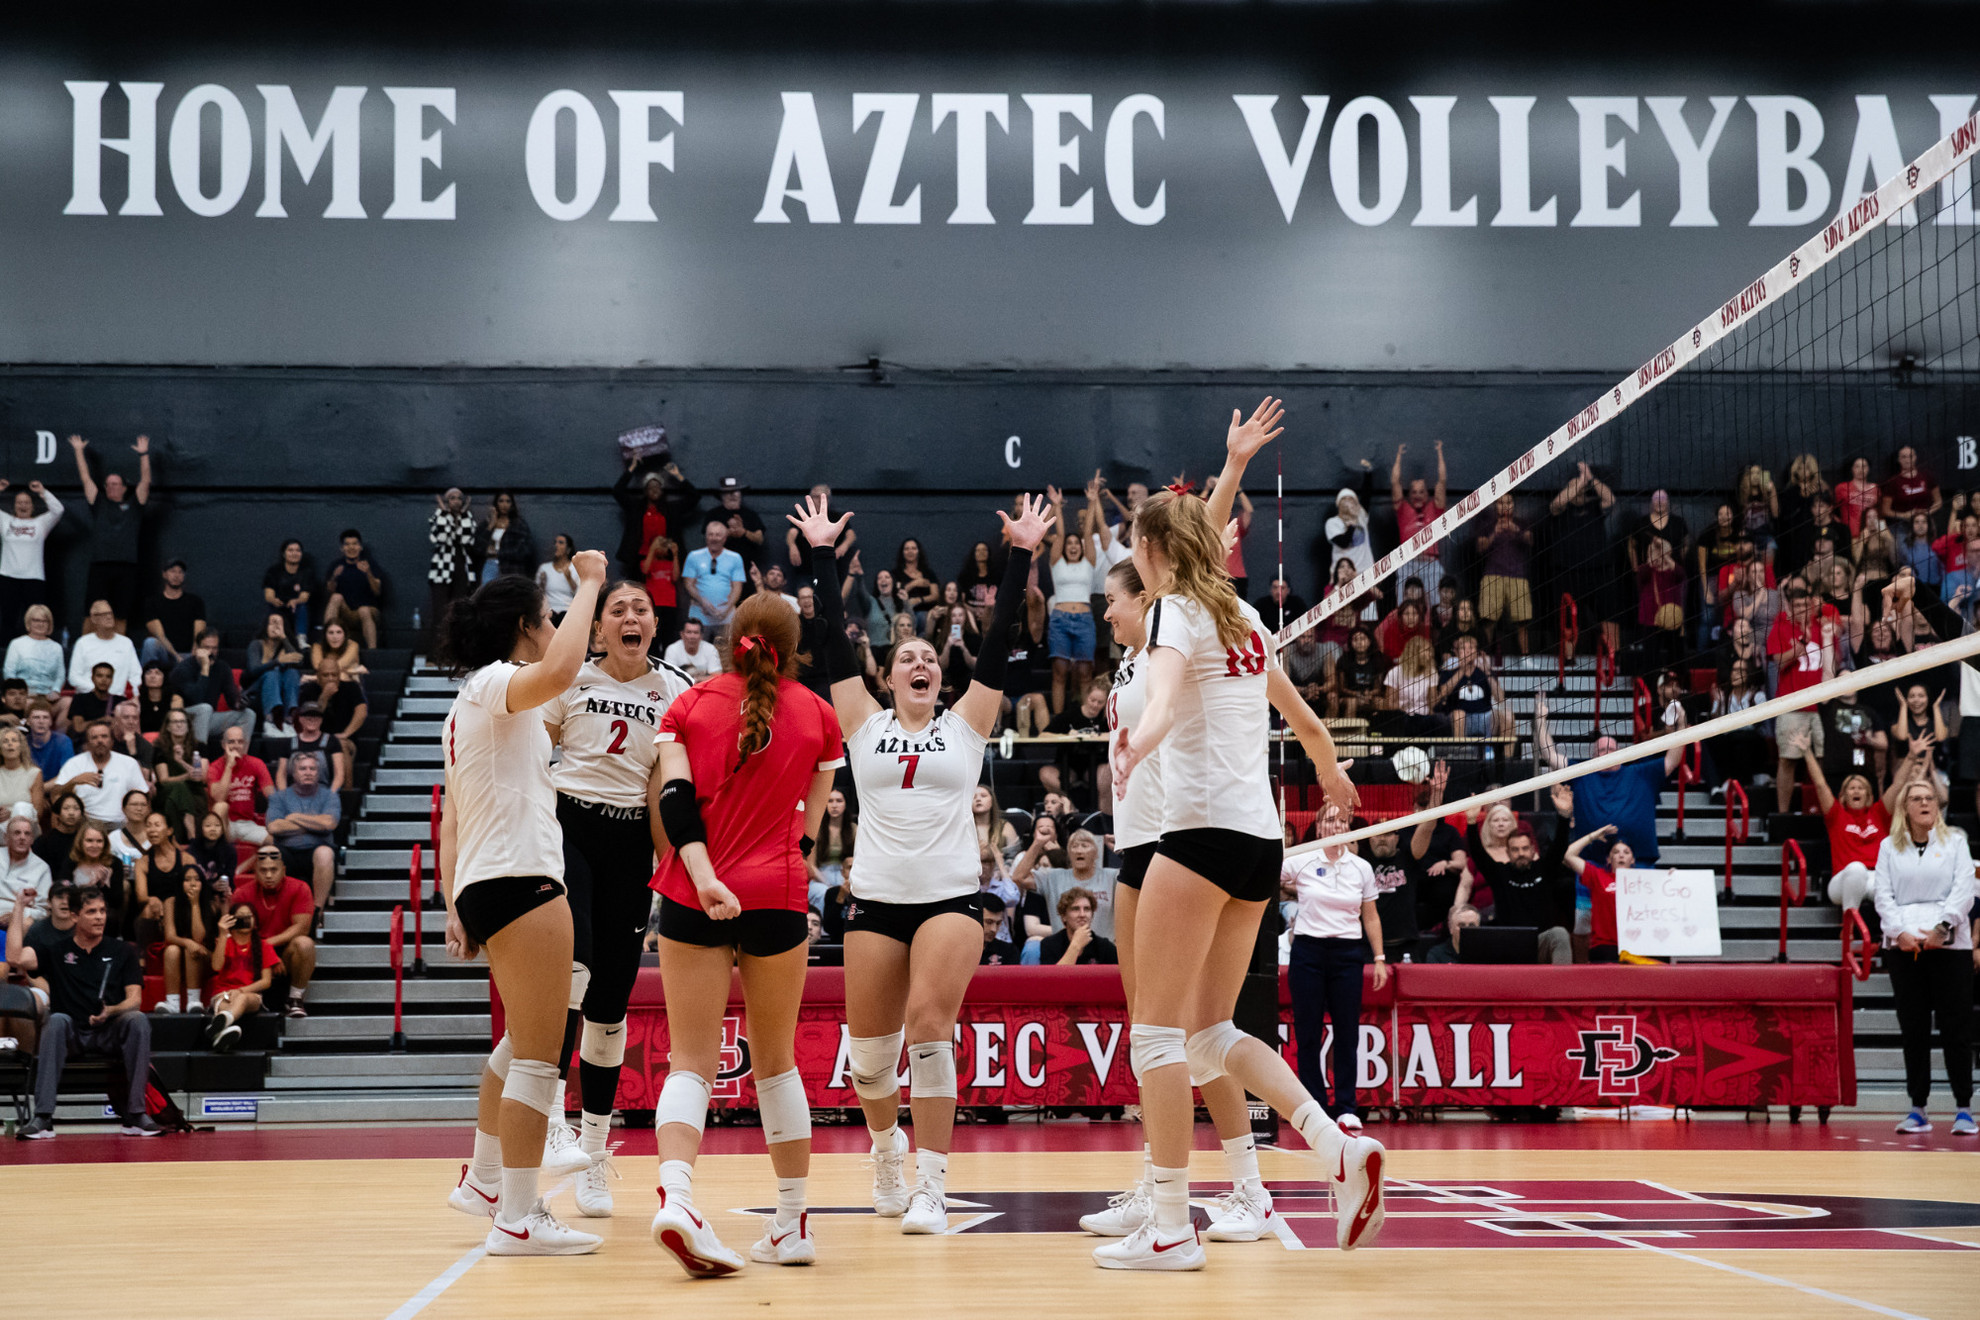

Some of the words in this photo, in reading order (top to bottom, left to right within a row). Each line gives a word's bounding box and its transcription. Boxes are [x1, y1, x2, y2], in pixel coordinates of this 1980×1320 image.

[63, 81, 457, 220] HOME
[525, 89, 685, 222] OF
[753, 91, 1166, 226] AZTEC
[36, 430, 57, 464] D
[1004, 435, 1021, 469] C
[1957, 436, 1978, 469] B
[585, 697, 656, 726] AZTECS
[606, 719, 629, 755] 2
[874, 736, 946, 755] AZTECS
[898, 754, 920, 790] 7
[600, 803, 643, 821] NIKE
